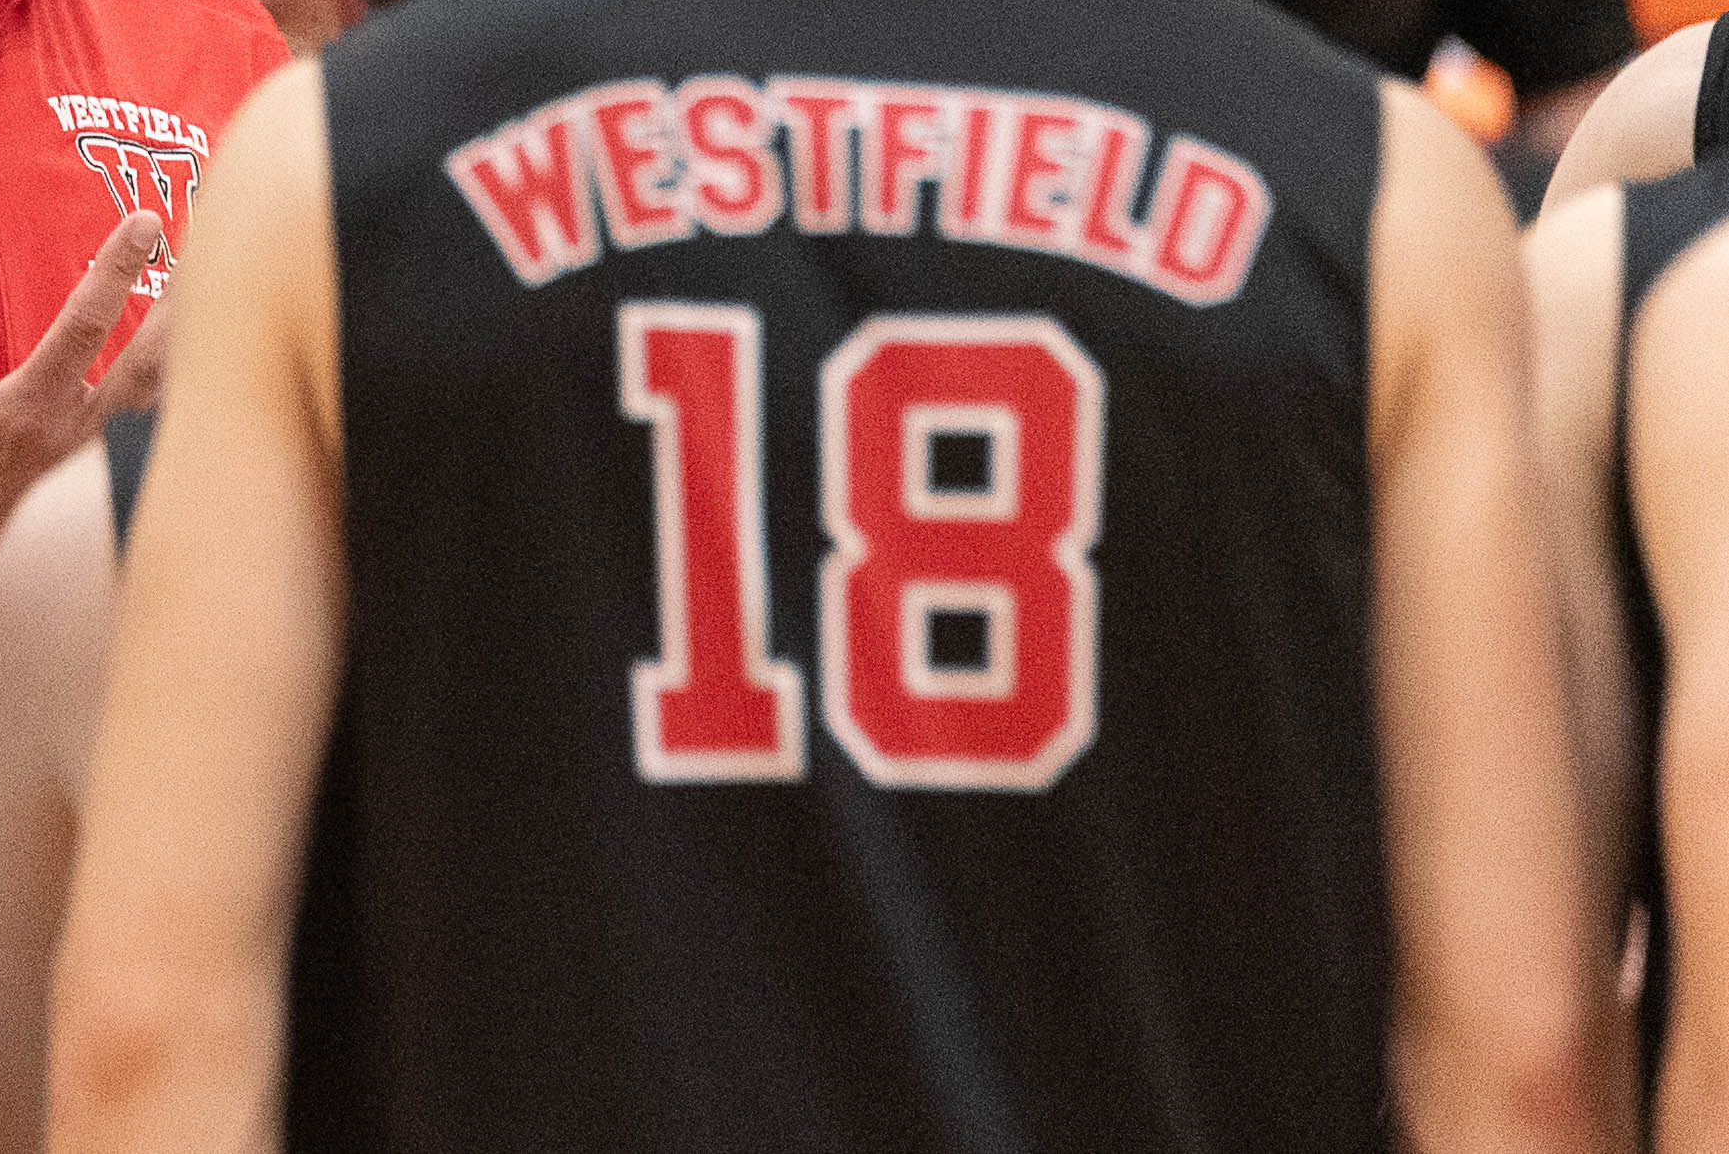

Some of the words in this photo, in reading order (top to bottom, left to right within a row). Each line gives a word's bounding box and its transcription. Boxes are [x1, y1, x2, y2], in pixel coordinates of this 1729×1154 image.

[48, 94, 210, 158] WESTFIELD
[446, 74, 1272, 308] WESTFIELD
[616, 300, 1110, 794] 18
